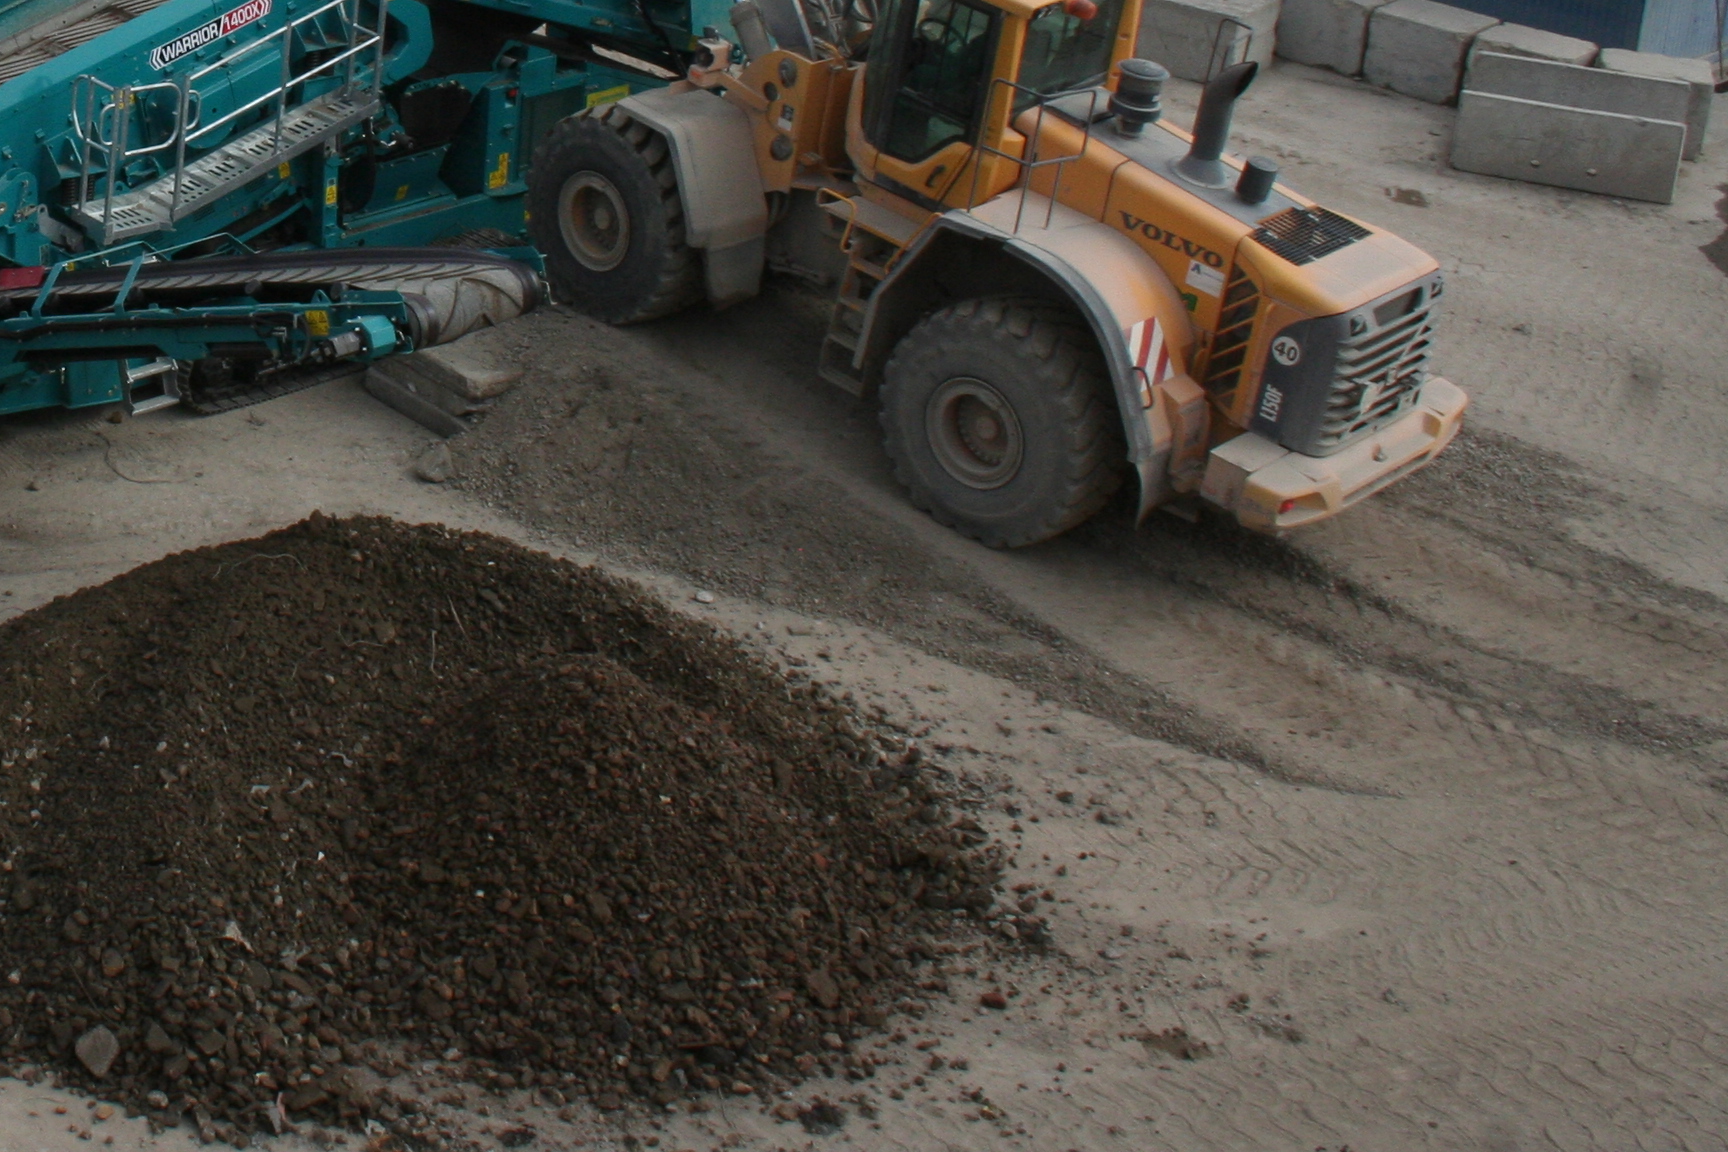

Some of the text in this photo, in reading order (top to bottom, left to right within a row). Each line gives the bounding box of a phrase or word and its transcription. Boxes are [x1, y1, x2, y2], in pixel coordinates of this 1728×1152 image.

[161, 1, 259, 62] WARRIOR 1400X
[1118, 210, 1224, 268] VOLVO
[1274, 342, 1297, 361] 40
[1259, 384, 1283, 423] L150F
